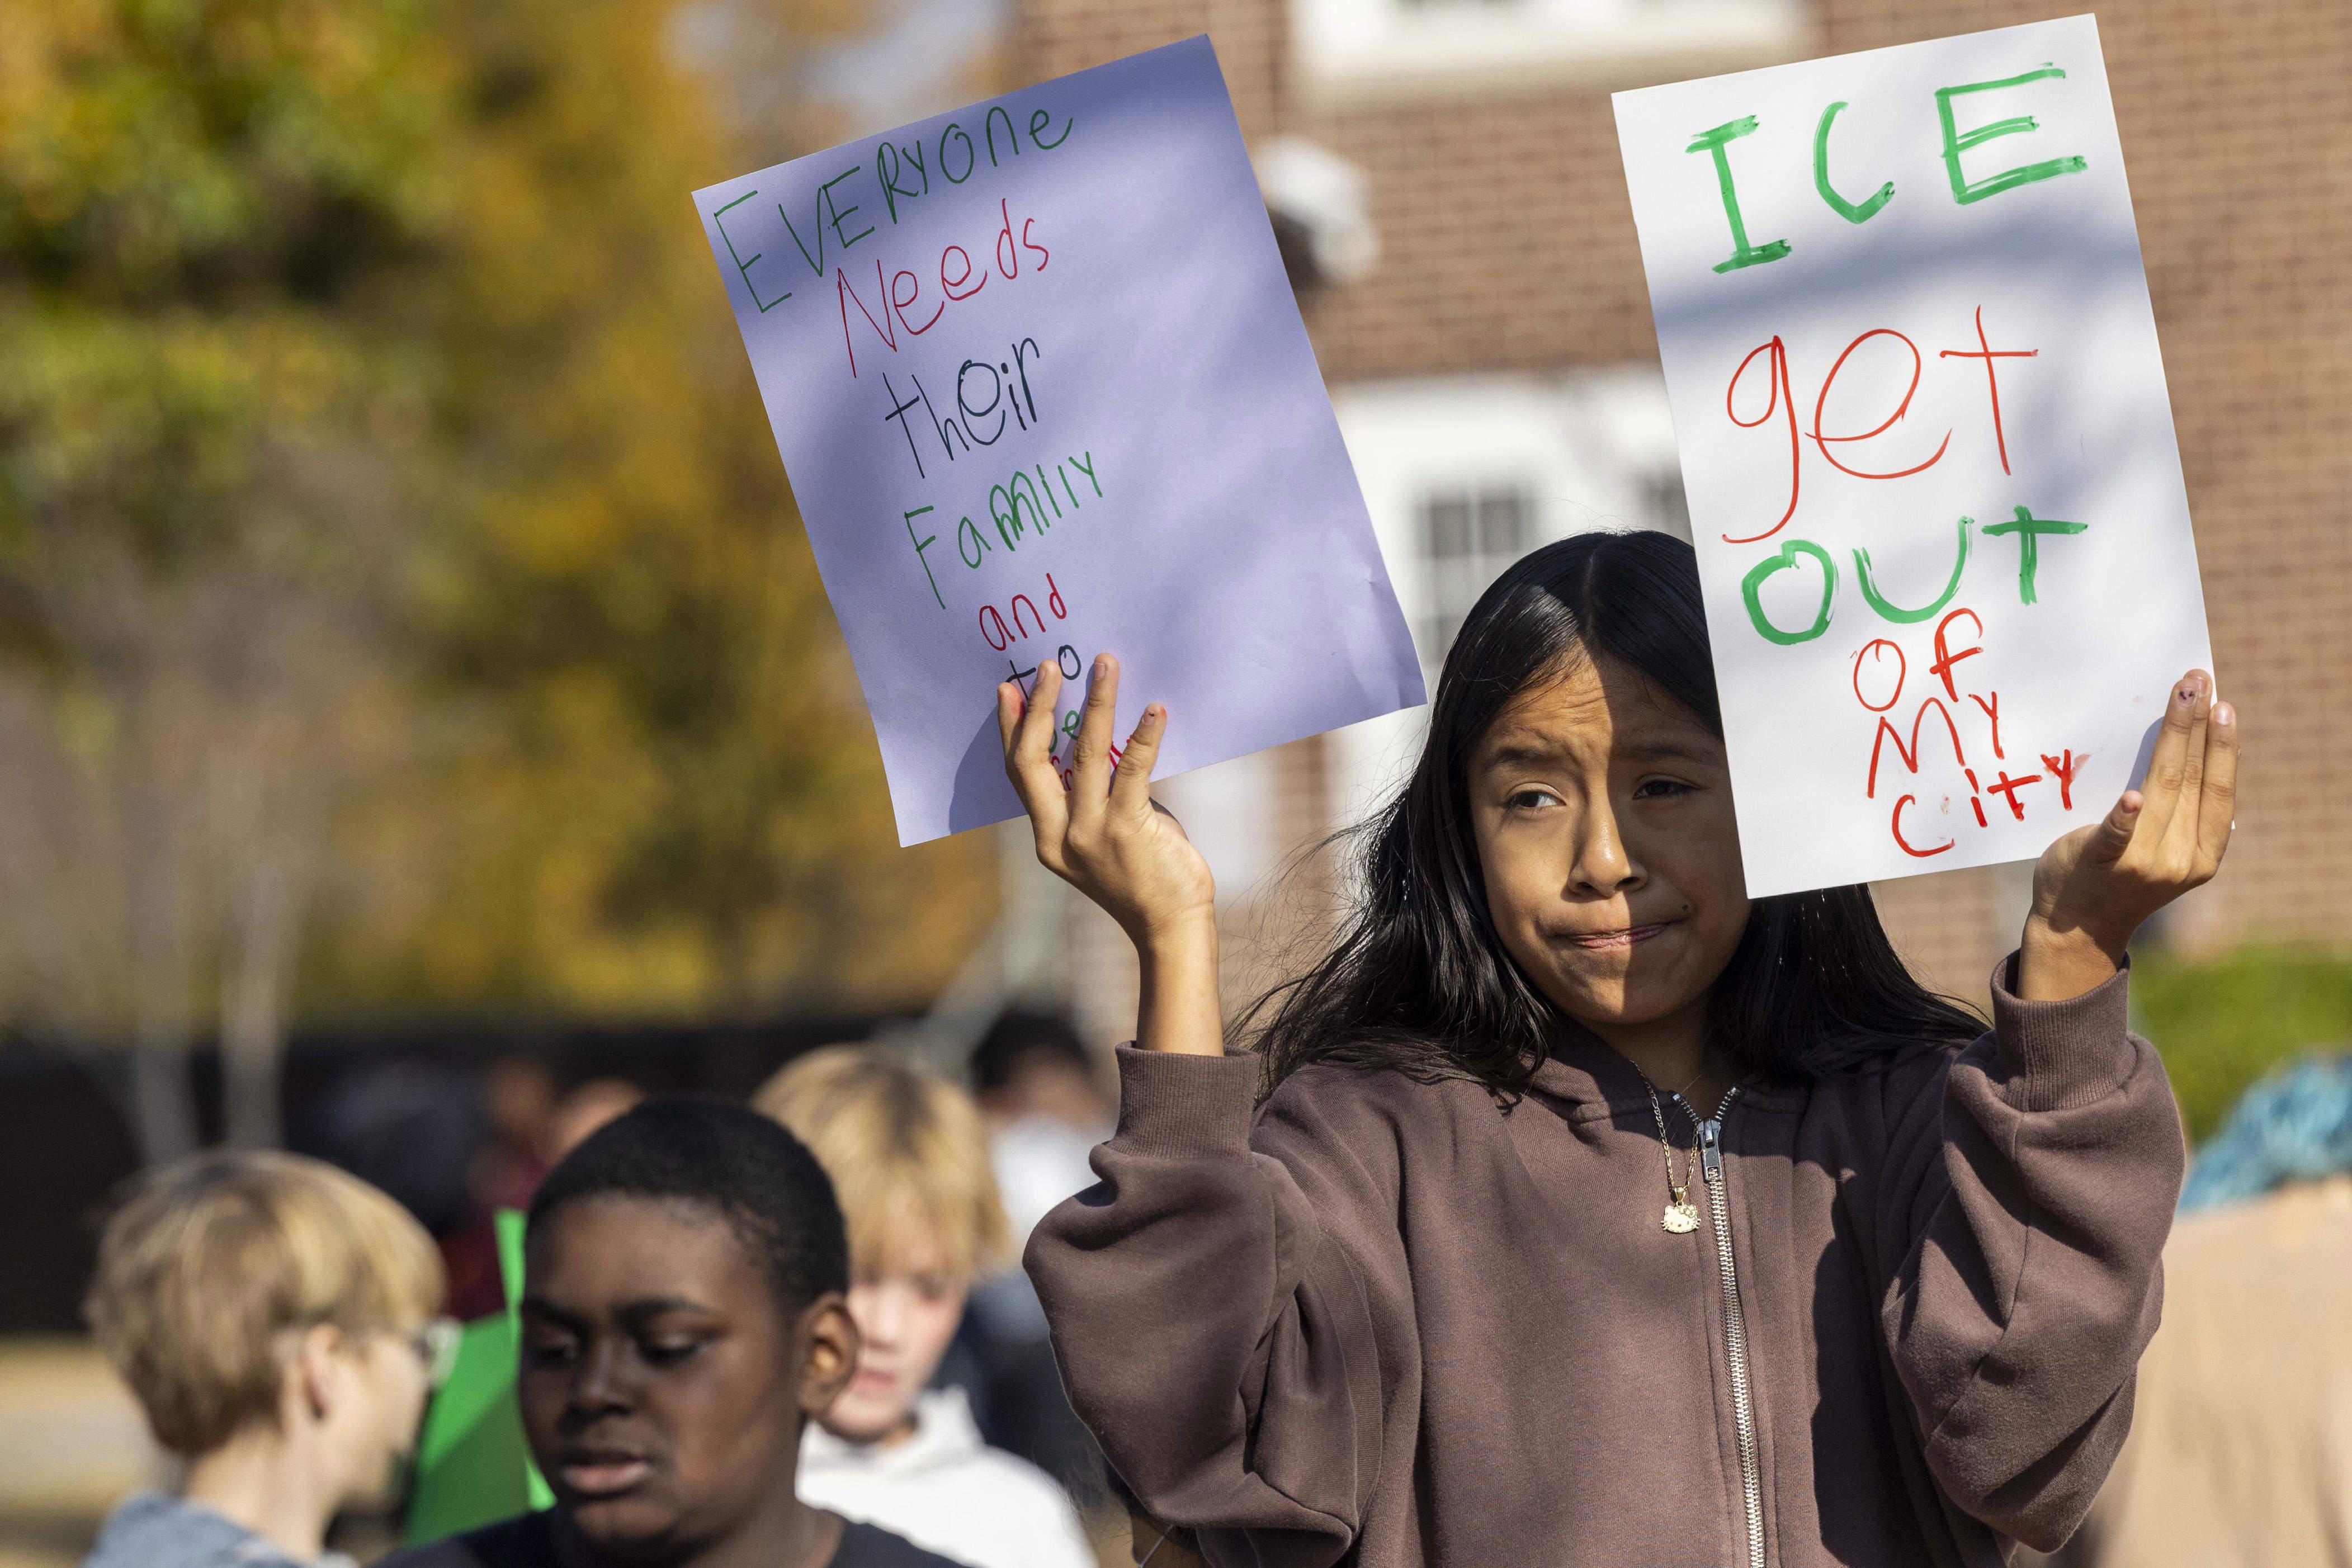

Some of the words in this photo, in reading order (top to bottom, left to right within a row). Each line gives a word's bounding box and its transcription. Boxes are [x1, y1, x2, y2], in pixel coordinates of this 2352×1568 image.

[1685, 63, 2087, 274] ICE
[837, 198, 1049, 378] Needs
[883, 337, 1040, 479] their
[1722, 304, 2039, 544] get
[979, 573, 1068, 651] and
